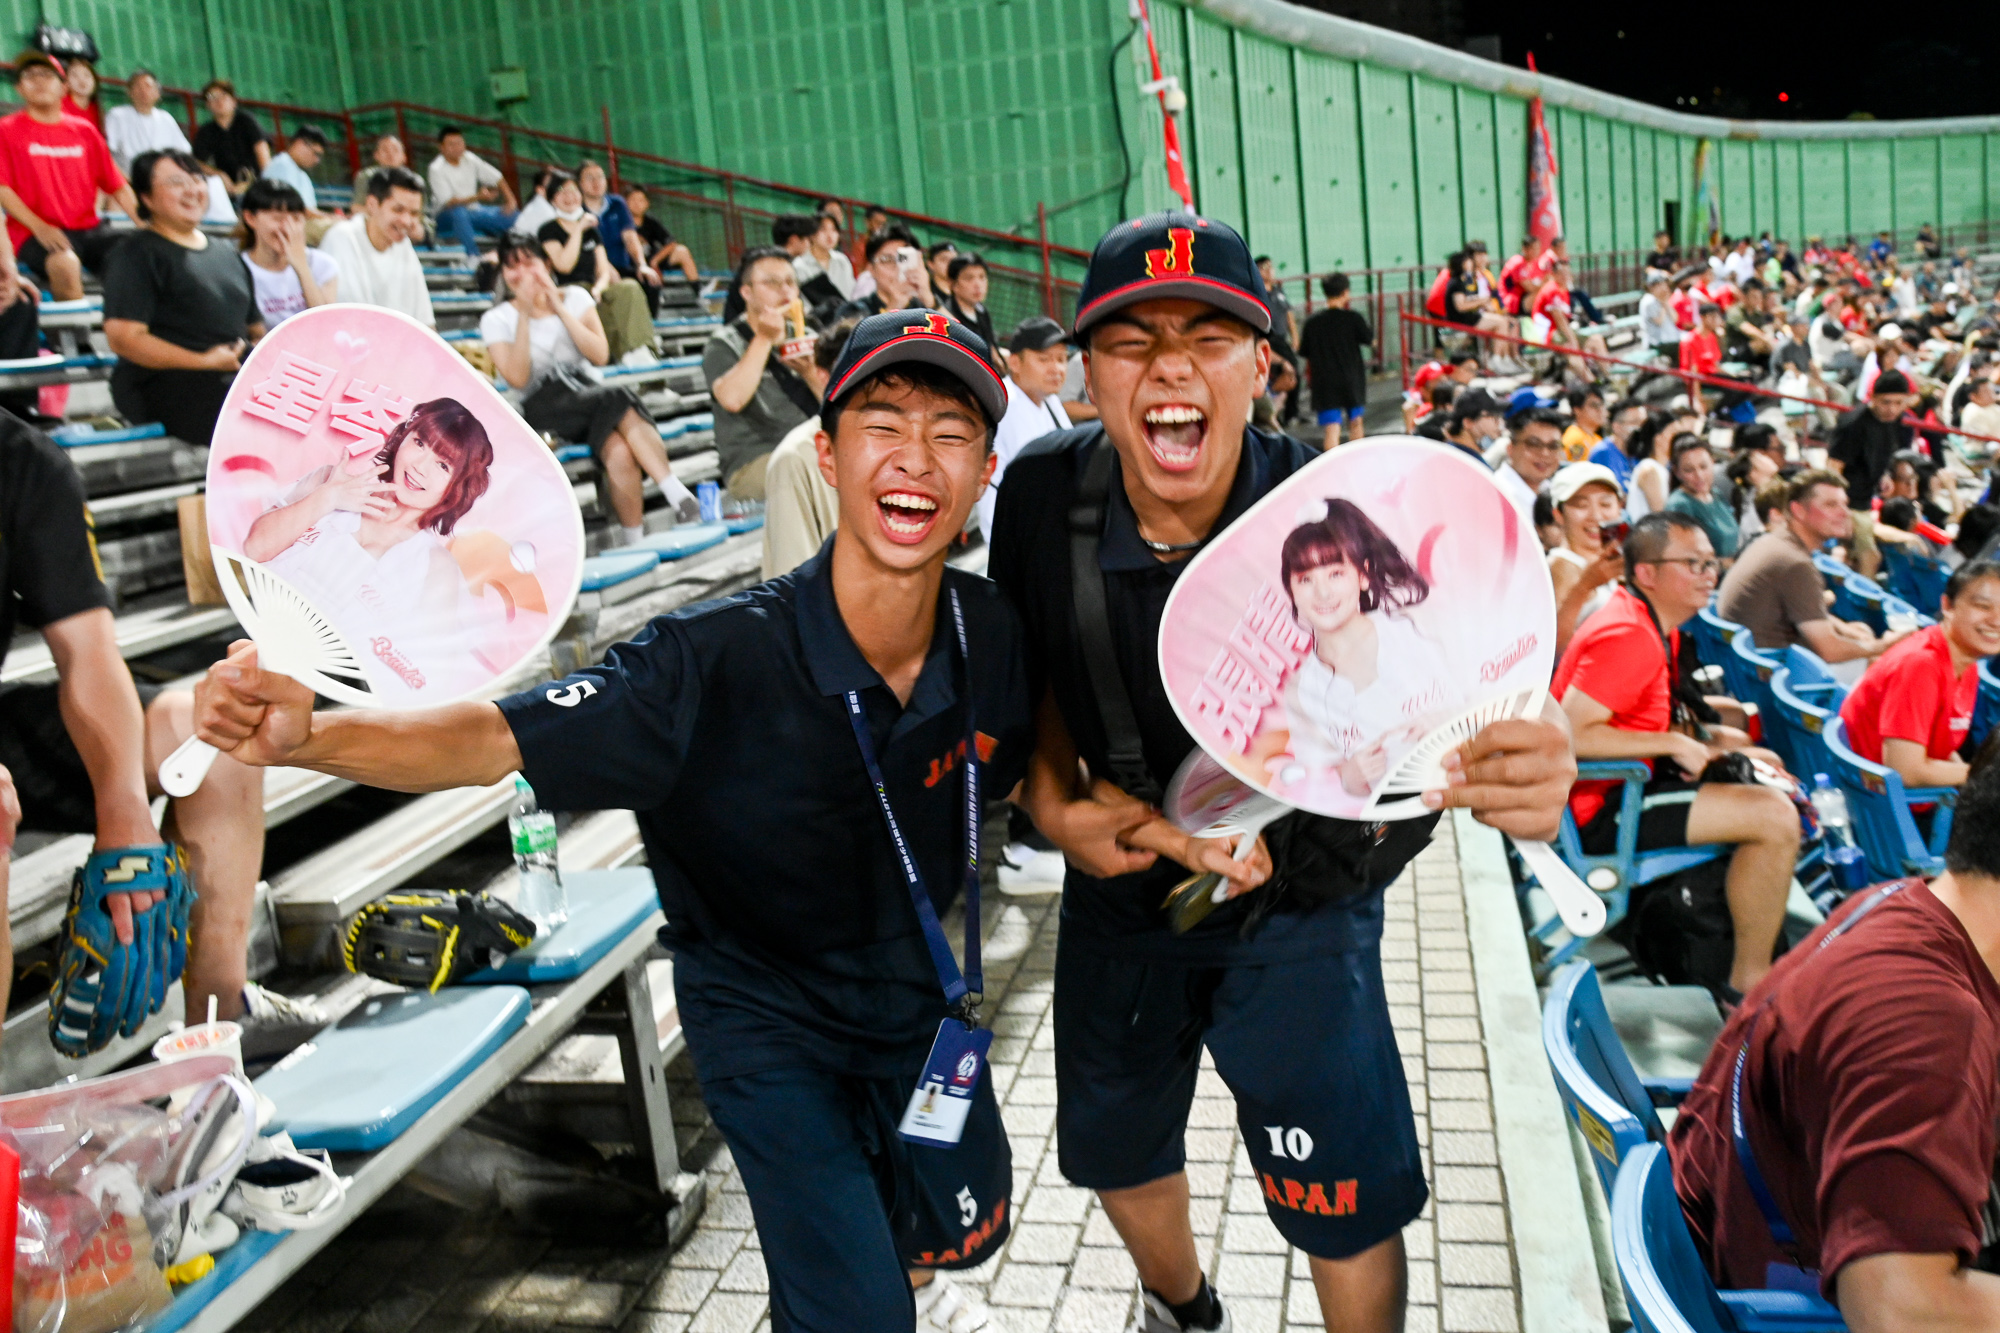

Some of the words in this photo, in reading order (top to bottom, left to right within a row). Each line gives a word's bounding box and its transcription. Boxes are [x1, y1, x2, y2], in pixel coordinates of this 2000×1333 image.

[1145, 227, 1195, 279] J
[903, 312, 950, 337] J
[241, 350, 414, 458] 星岑
[546, 679, 598, 707] 5
[1263, 1125, 1314, 1162] 10
[955, 1184, 978, 1228] 5
[1253, 1167, 1358, 1216] APAN
